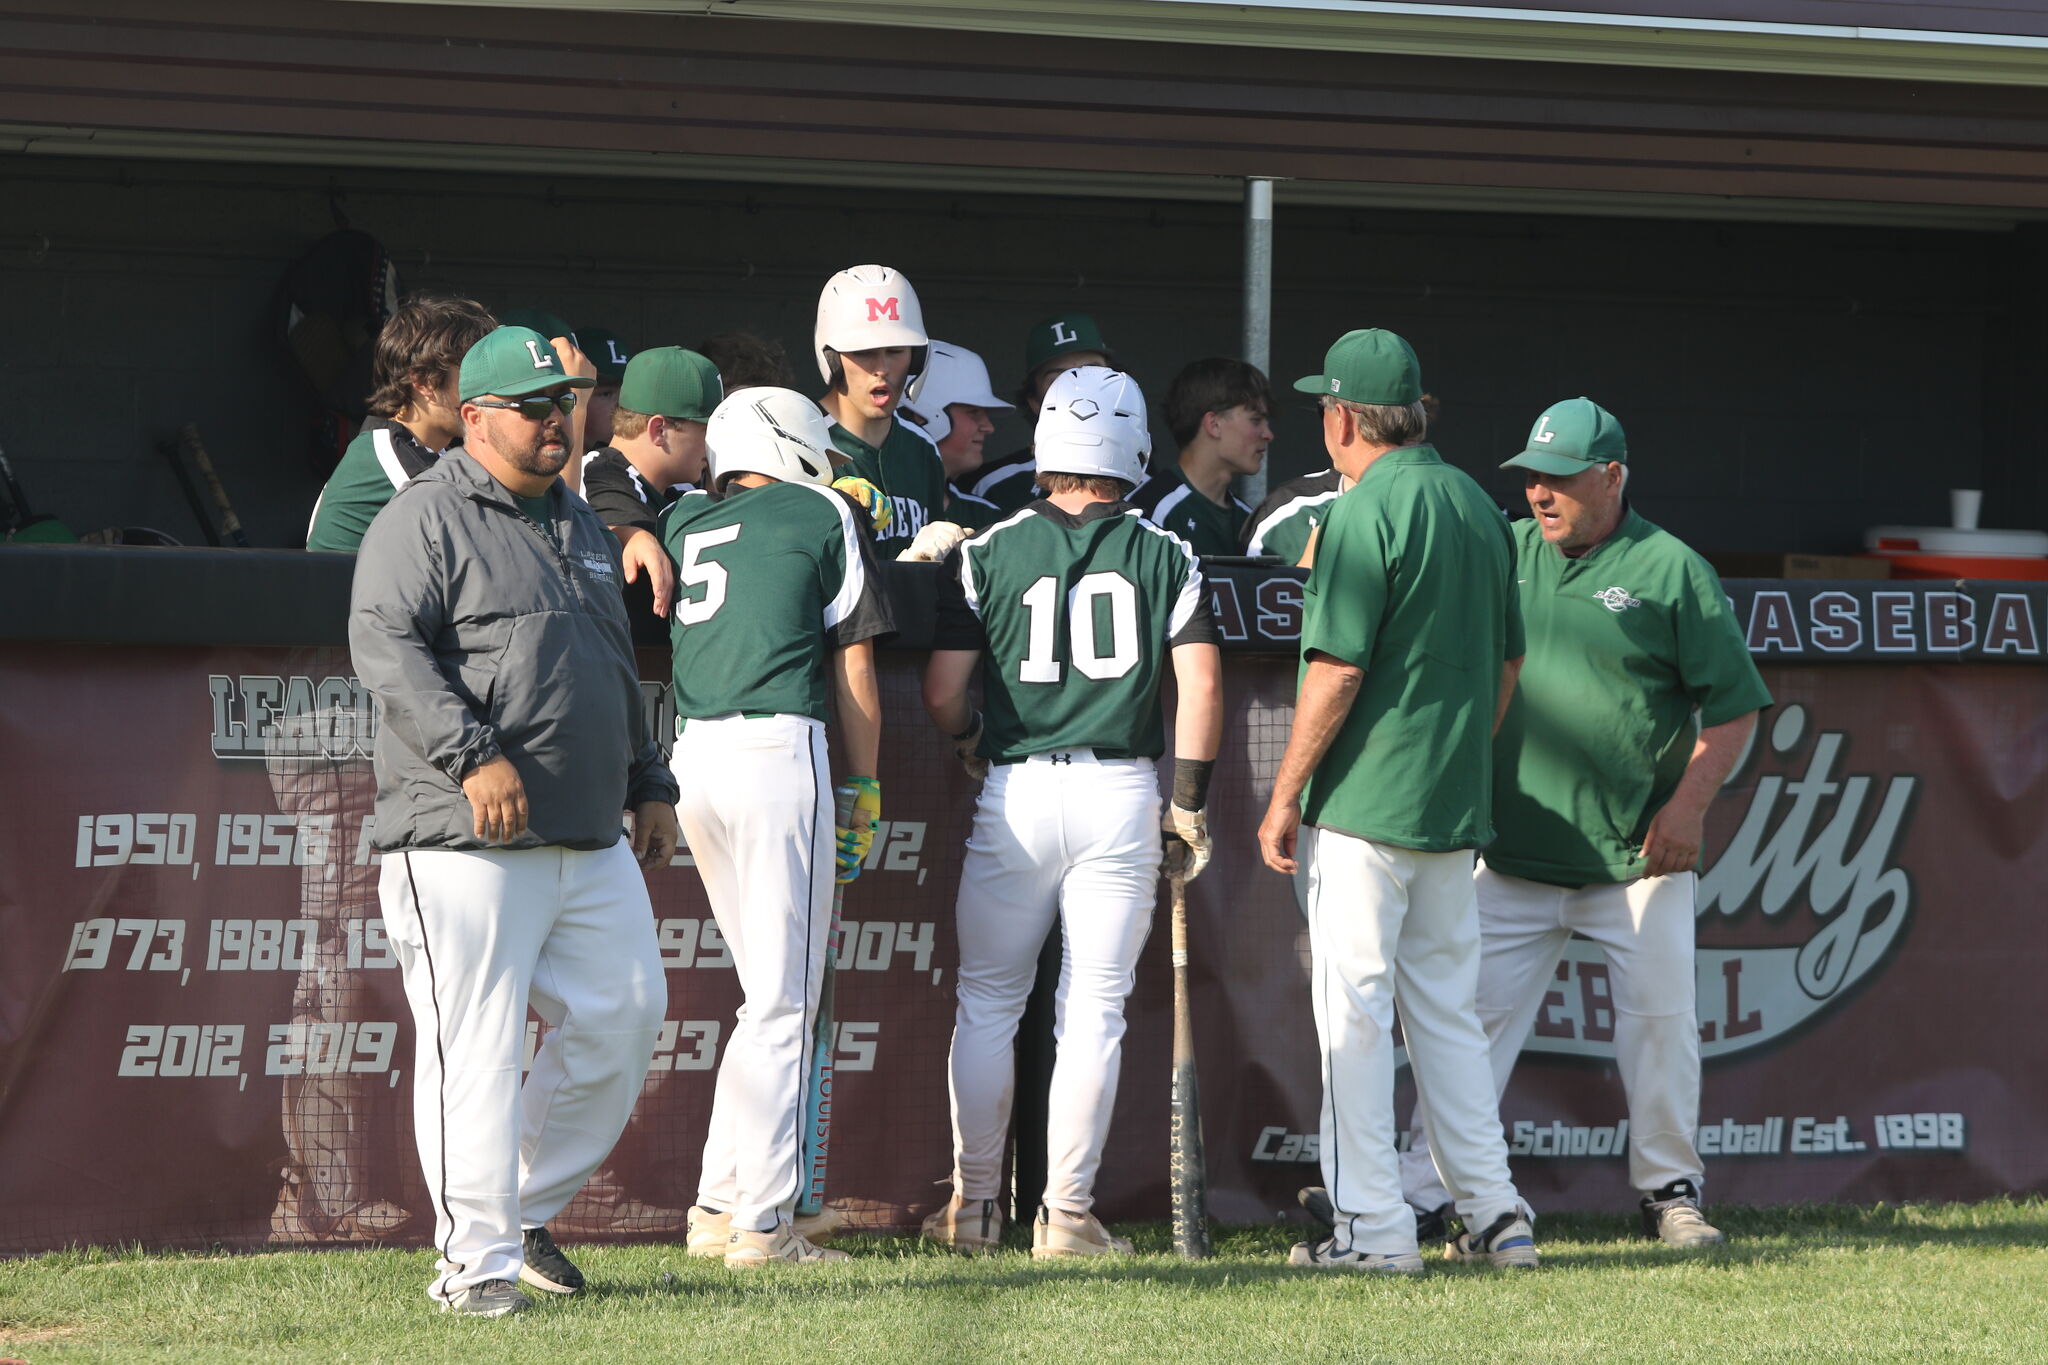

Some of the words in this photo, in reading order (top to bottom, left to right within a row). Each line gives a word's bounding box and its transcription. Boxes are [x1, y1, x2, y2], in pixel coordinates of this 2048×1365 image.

[866, 297, 900, 321] M
[1051, 321, 1077, 346] L
[526, 339, 553, 370] L
[606, 340, 628, 365] L
[1533, 415, 1555, 443] L
[676, 523, 743, 627] 5
[1019, 570, 1140, 684] 10
[1726, 590, 2048, 653] ASEBA
[75, 813, 200, 881] 1950,
[1696, 703, 1916, 1001] ity
[62, 918, 191, 987] 1973,
[206, 918, 327, 986] 1980,
[117, 1024, 248, 1092] 2012,
[264, 1021, 401, 1088] 2019,
[1509, 1119, 1629, 1156] School
[1696, 1116, 1784, 1154] eball
[1791, 1116, 1867, 1152] Est.
[1874, 1113, 1964, 1148] 1898
